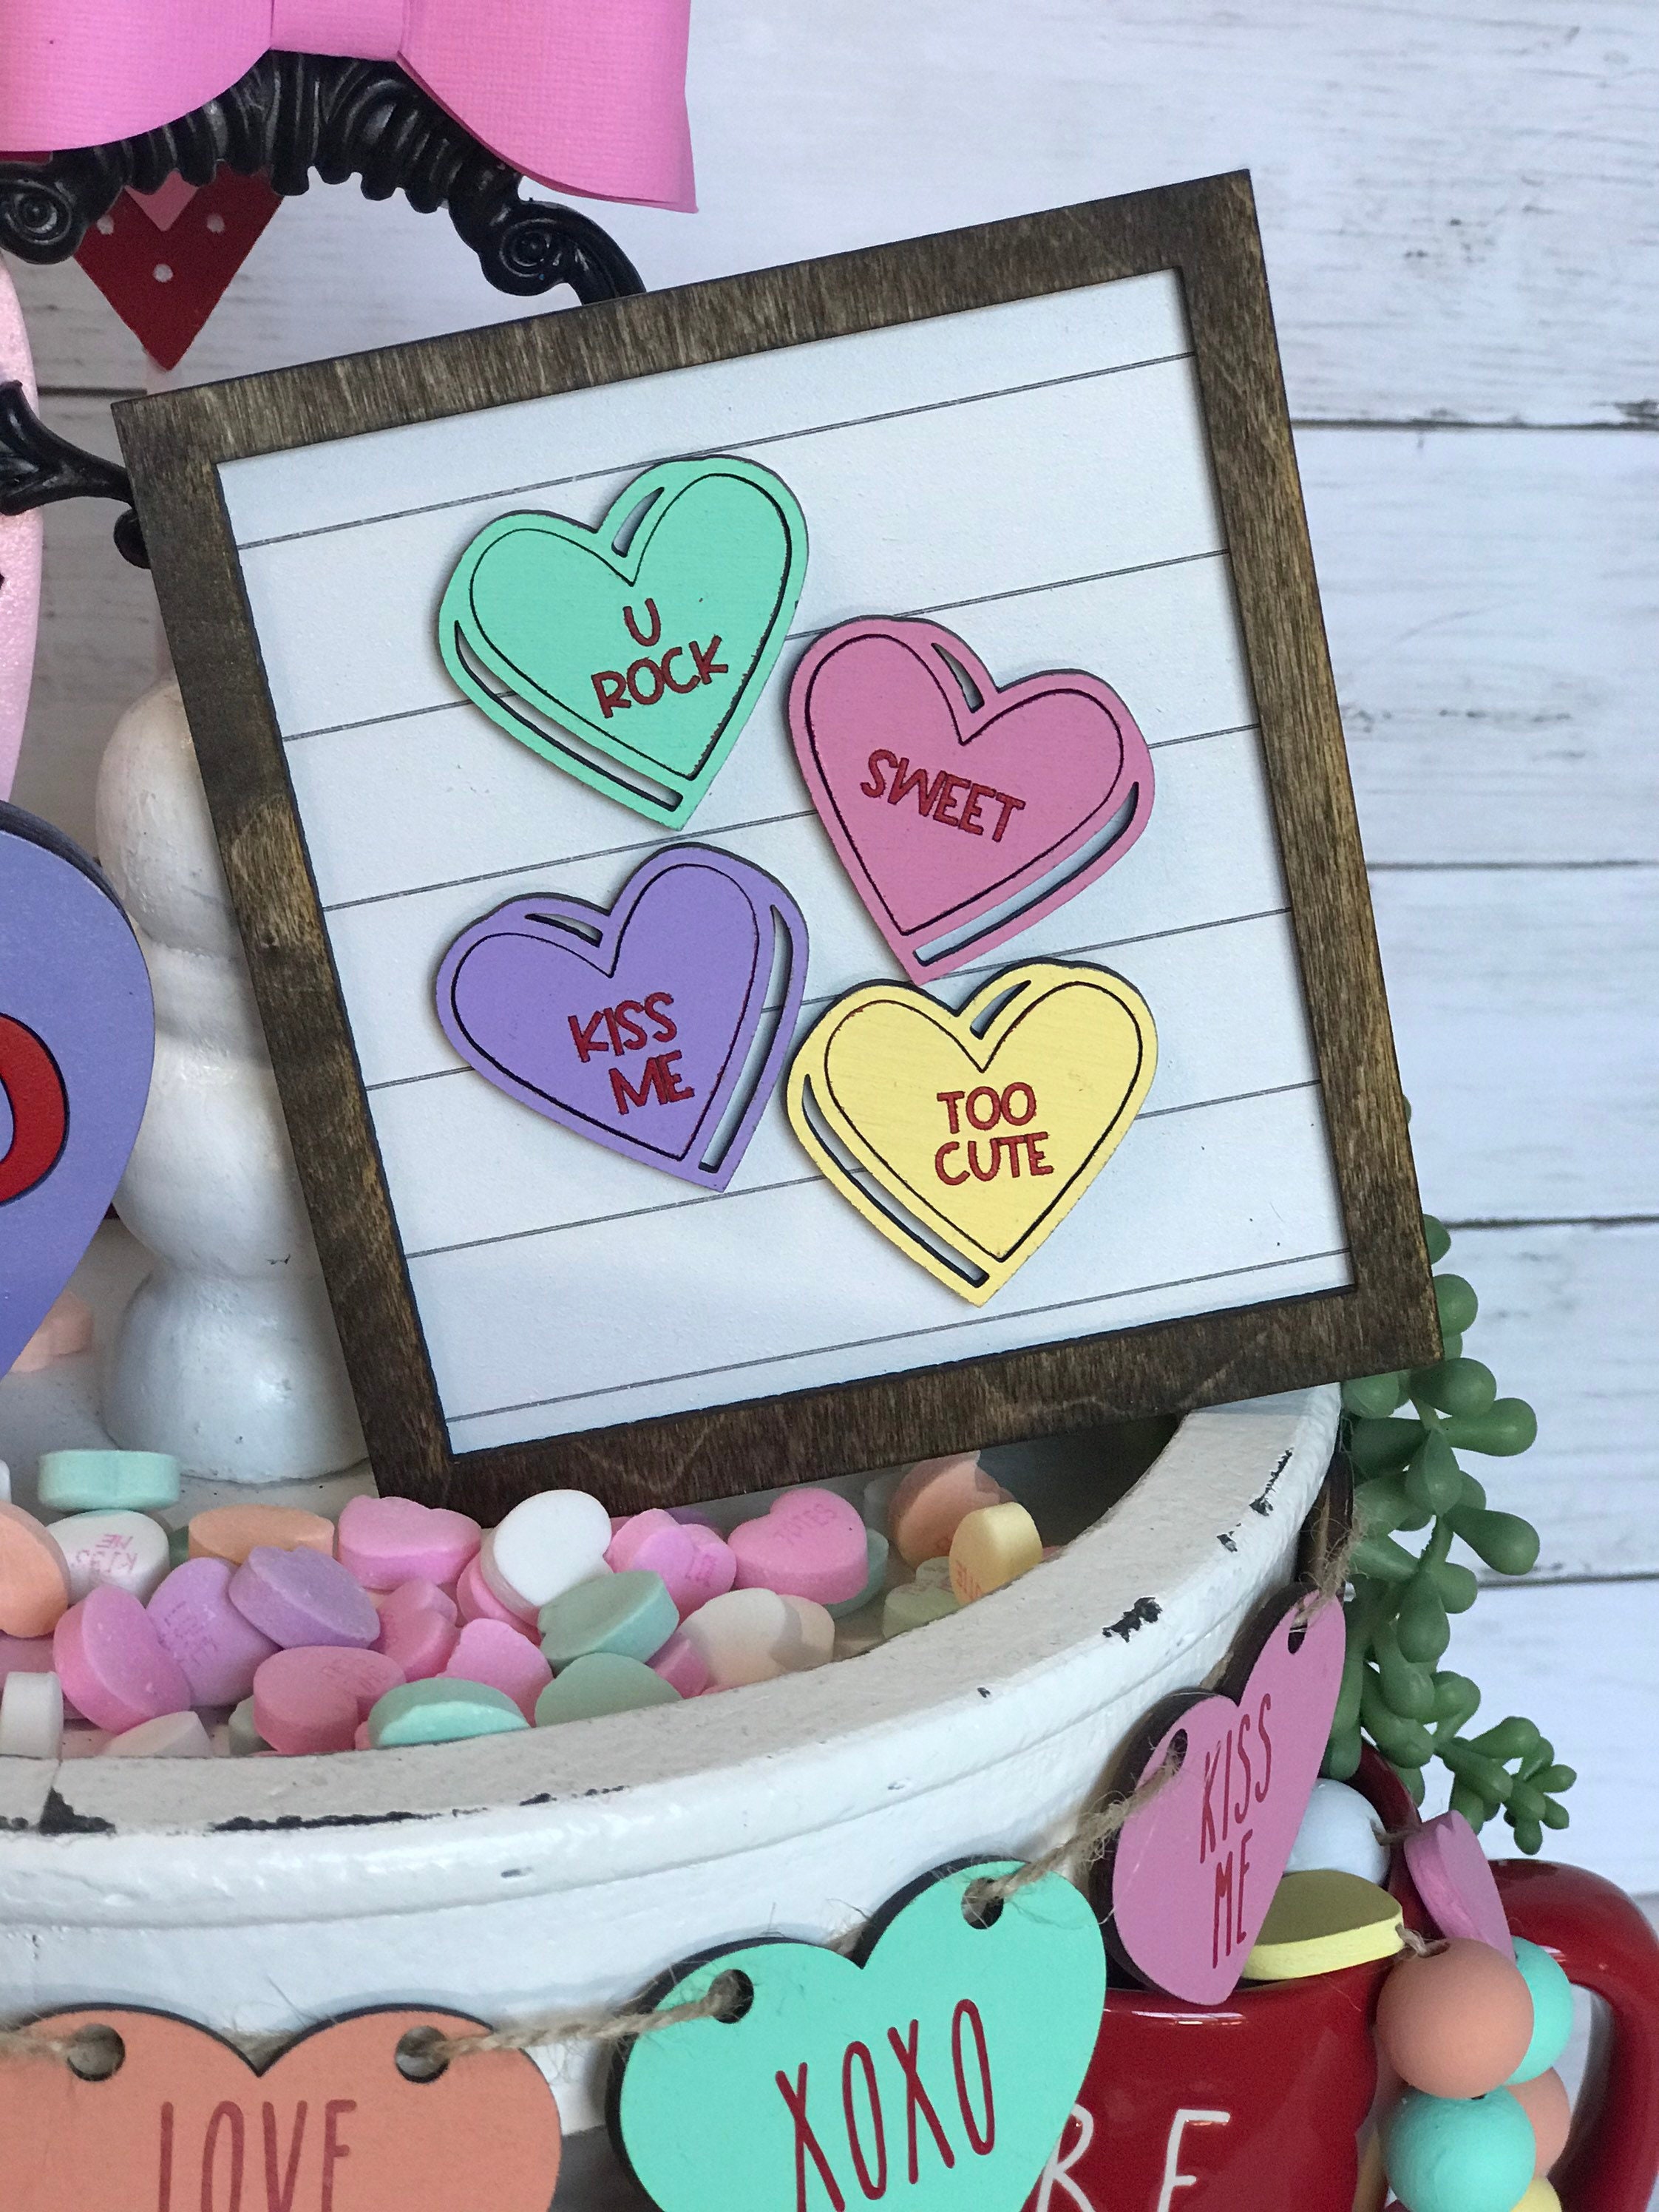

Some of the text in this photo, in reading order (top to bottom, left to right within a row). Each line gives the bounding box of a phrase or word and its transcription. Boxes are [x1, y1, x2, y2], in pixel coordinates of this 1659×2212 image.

[622, 597, 662, 648] U
[590, 634, 729, 719] ROCK
[859, 748, 1027, 844] SWEET
[567, 991, 678, 1064] KISS
[608, 1049, 696, 1116] ME
[936, 1082, 1037, 1135] TOO
[934, 1131, 1055, 1186] CUTE
[1200, 1693, 1272, 1864] KISS
[1212, 1828, 1253, 1970] ME
[775, 1998, 995, 2212] XOXO
